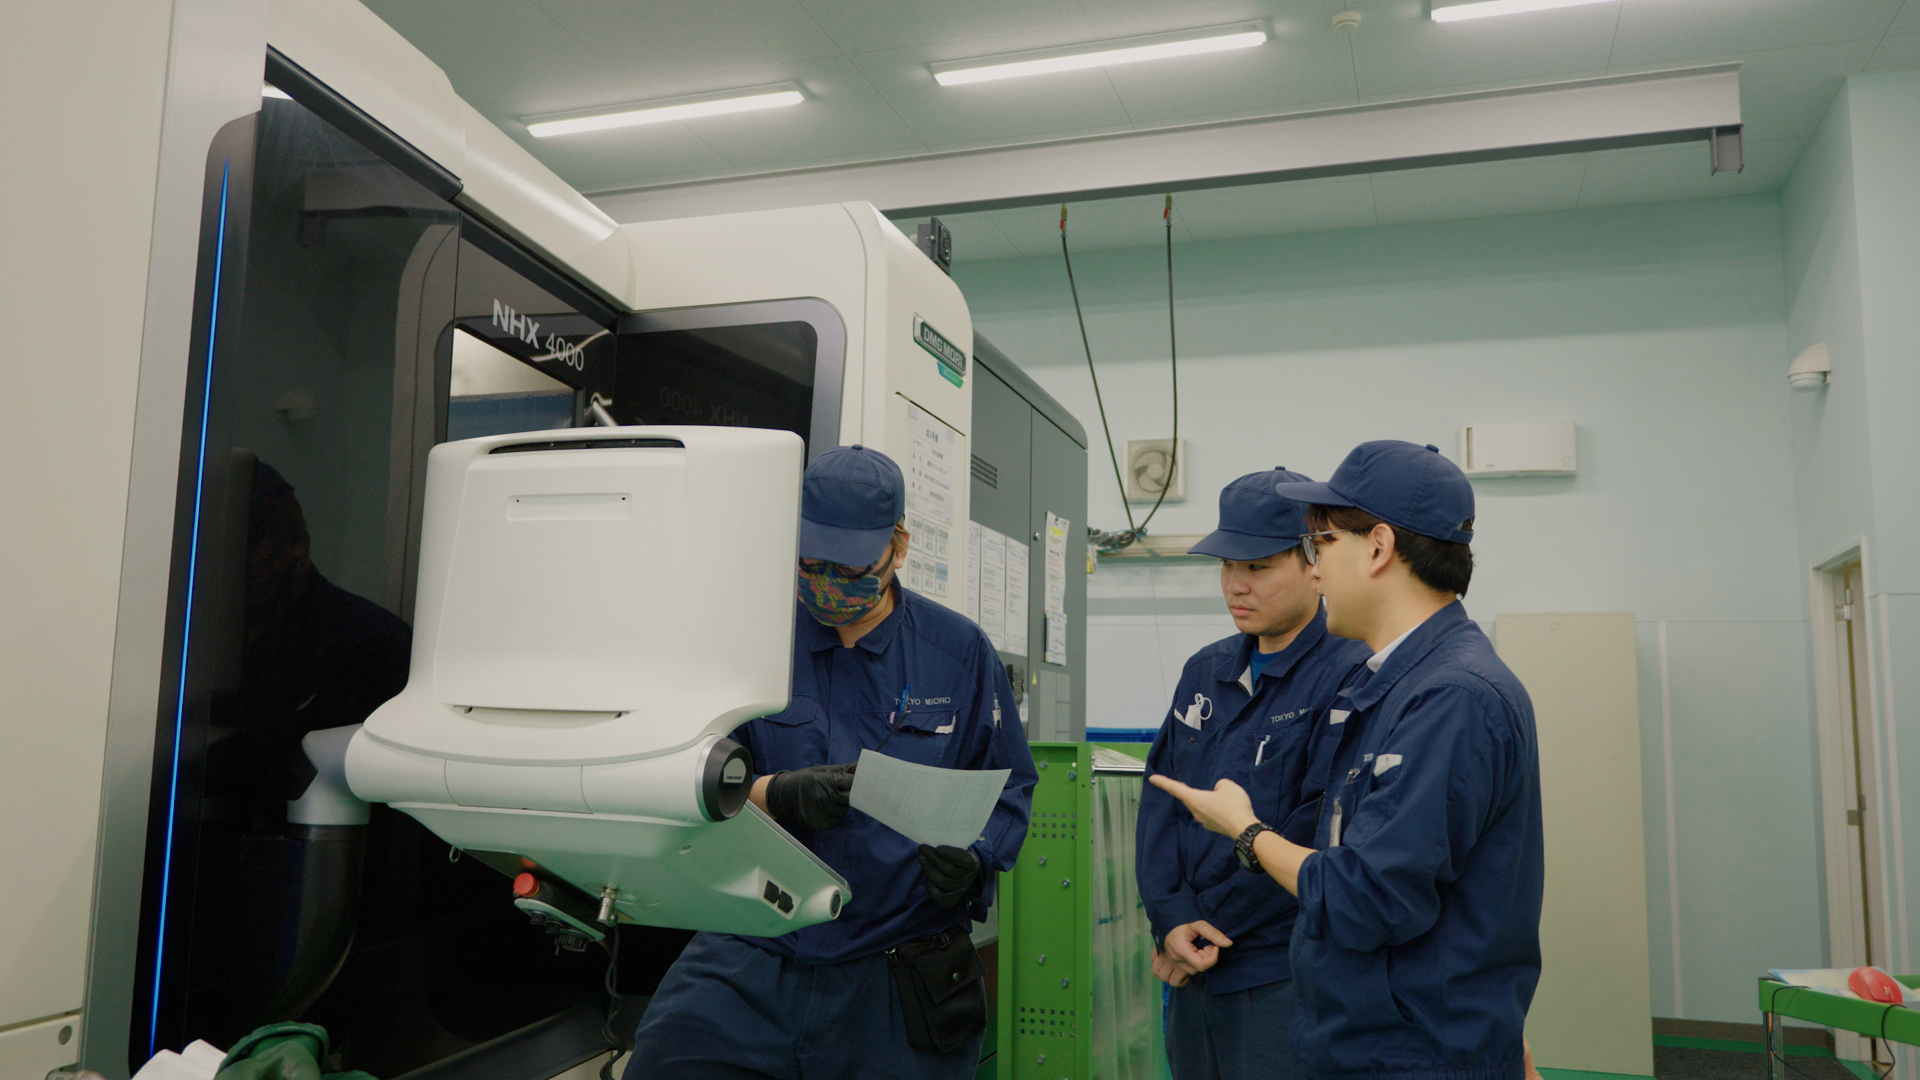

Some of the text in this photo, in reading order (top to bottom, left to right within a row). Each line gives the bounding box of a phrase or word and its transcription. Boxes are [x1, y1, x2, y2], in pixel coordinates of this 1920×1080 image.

[492, 298, 584, 372] NHX 4000
[923, 325, 963, 368] DMG MORI
[894, 696, 951, 706] TKYO MICRO
[1270, 711, 1295, 724] TOKYO
